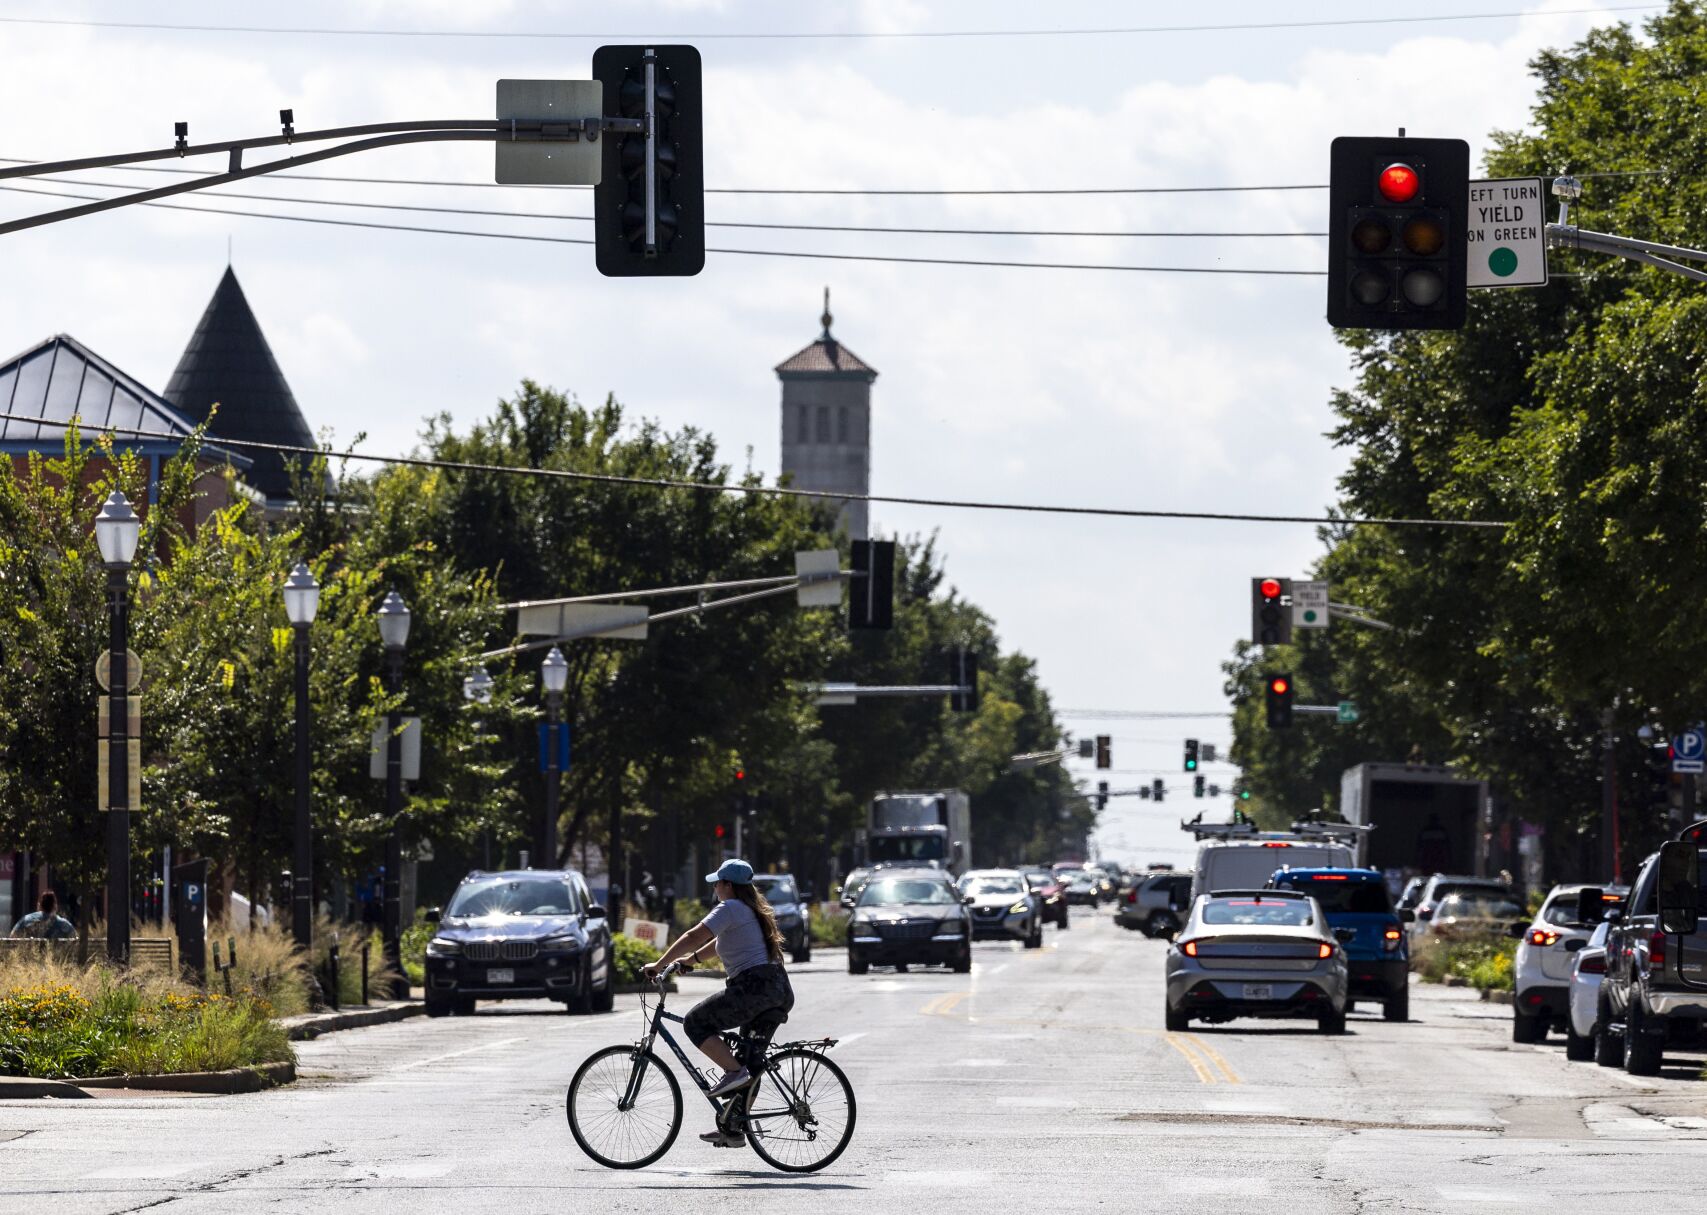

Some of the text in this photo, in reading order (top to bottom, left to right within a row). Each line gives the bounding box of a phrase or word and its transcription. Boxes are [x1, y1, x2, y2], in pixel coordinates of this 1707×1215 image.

[1471, 187, 1537, 201] EFT TURN
[1479, 206, 1523, 223] YIELD
[1468, 227, 1536, 242] ON GREEN
[1683, 732, 1698, 754] P
[188, 884, 198, 900] P
